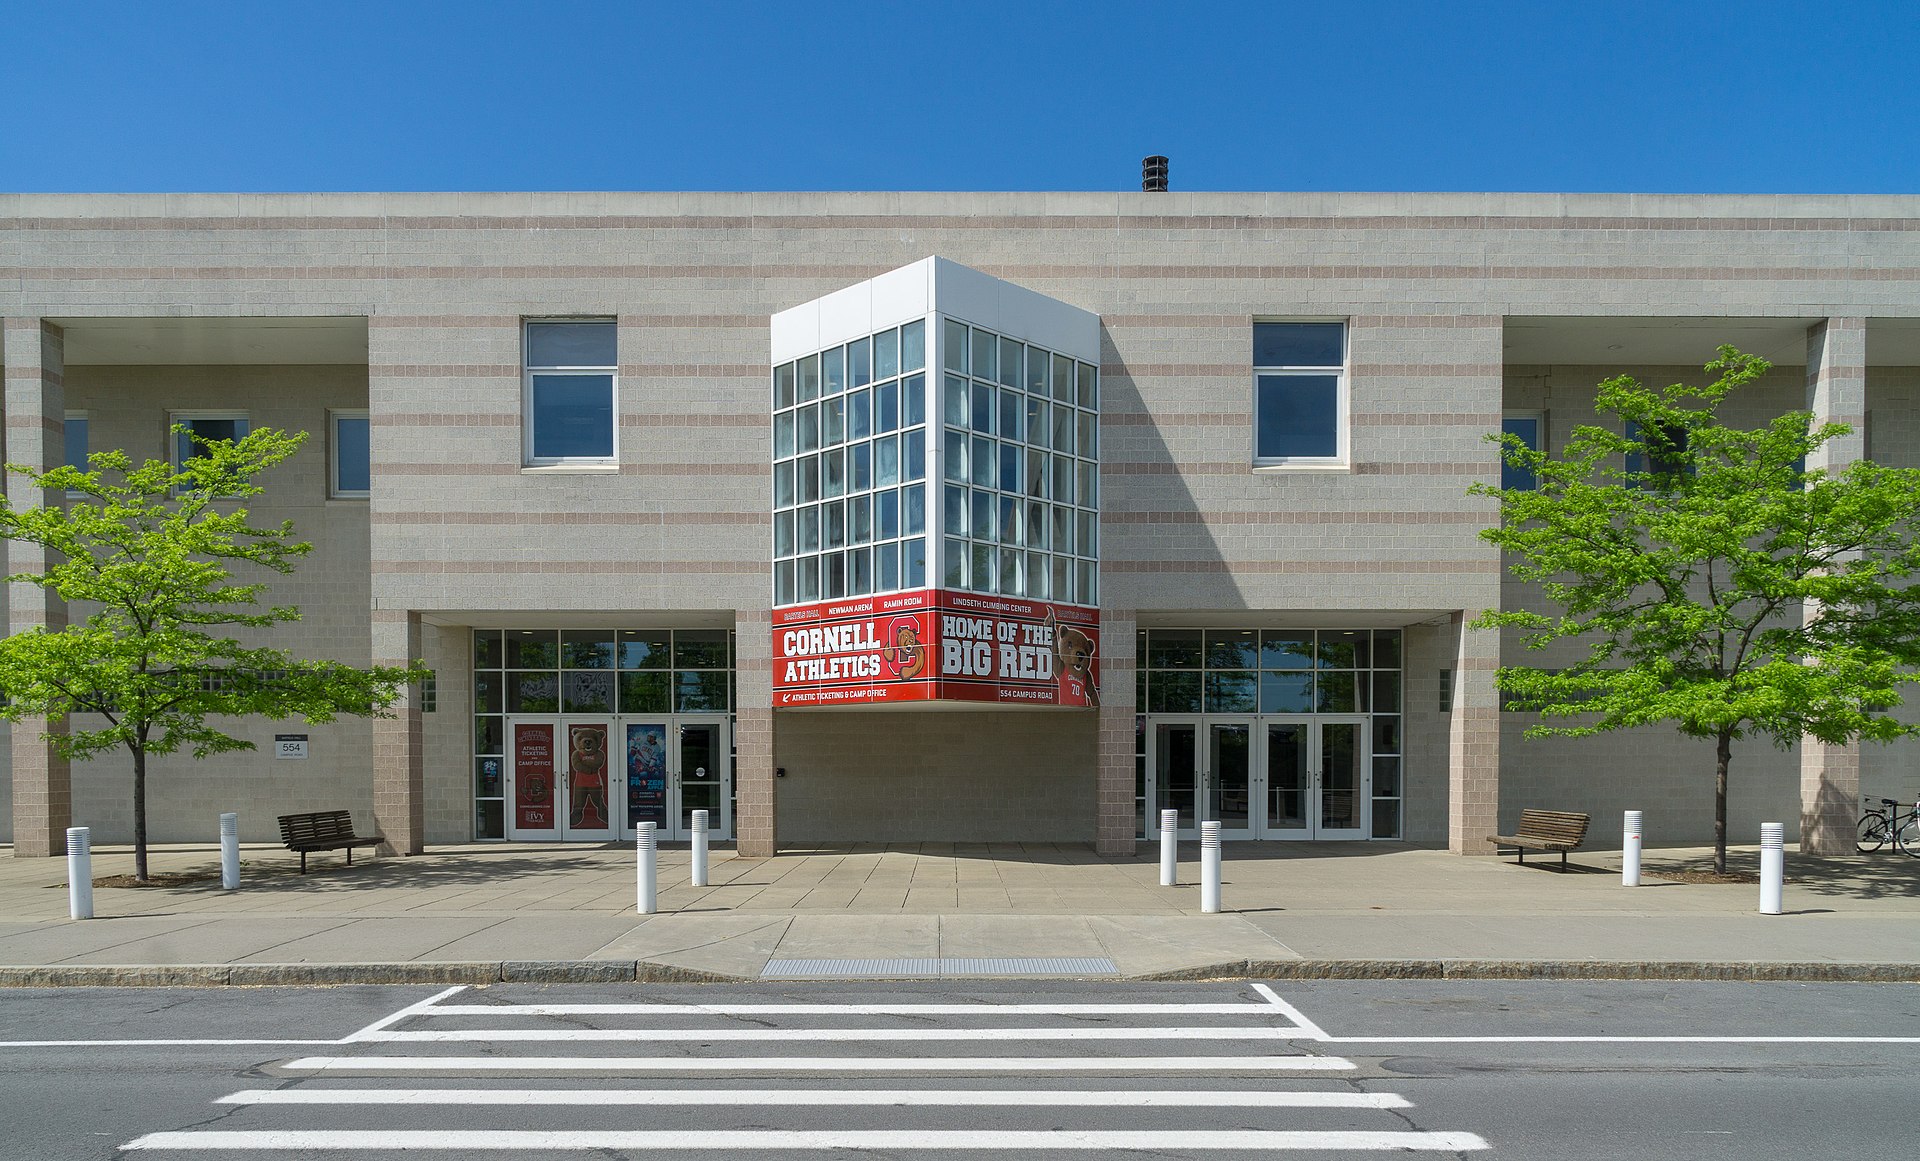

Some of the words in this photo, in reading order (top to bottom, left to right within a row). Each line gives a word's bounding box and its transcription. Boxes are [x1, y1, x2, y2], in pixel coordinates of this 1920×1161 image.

[828, 606, 853, 614] NEWMAN
[854, 604, 873, 612] ARENA
[884, 599, 902, 608] RAMIN
[904, 597, 922, 606] ROOM
[953, 598, 982, 608] LINDSETH
[982, 600, 1010, 611] CLIMBING
[1010, 603, 1032, 613] CENTER
[942, 616, 992, 640] HOME
[997, 622, 1018, 642] OF
[1022, 623, 1052, 646] THE
[784, 622, 880, 656] CORNELL
[942, 638, 992, 676] BIG
[1000, 644, 1052, 680] RED
[784, 654, 880, 682] ATHLETICS
[792, 693, 816, 701] ATHLETIC
[817, 690, 844, 700] TICKETING
[850, 690, 866, 698] CAMP
[867, 689, 886, 697] OFFICE
[1000, 690, 1012, 698] 554
[1012, 690, 1036, 698] CAMPUS
[1072, 684, 1080, 696] 70
